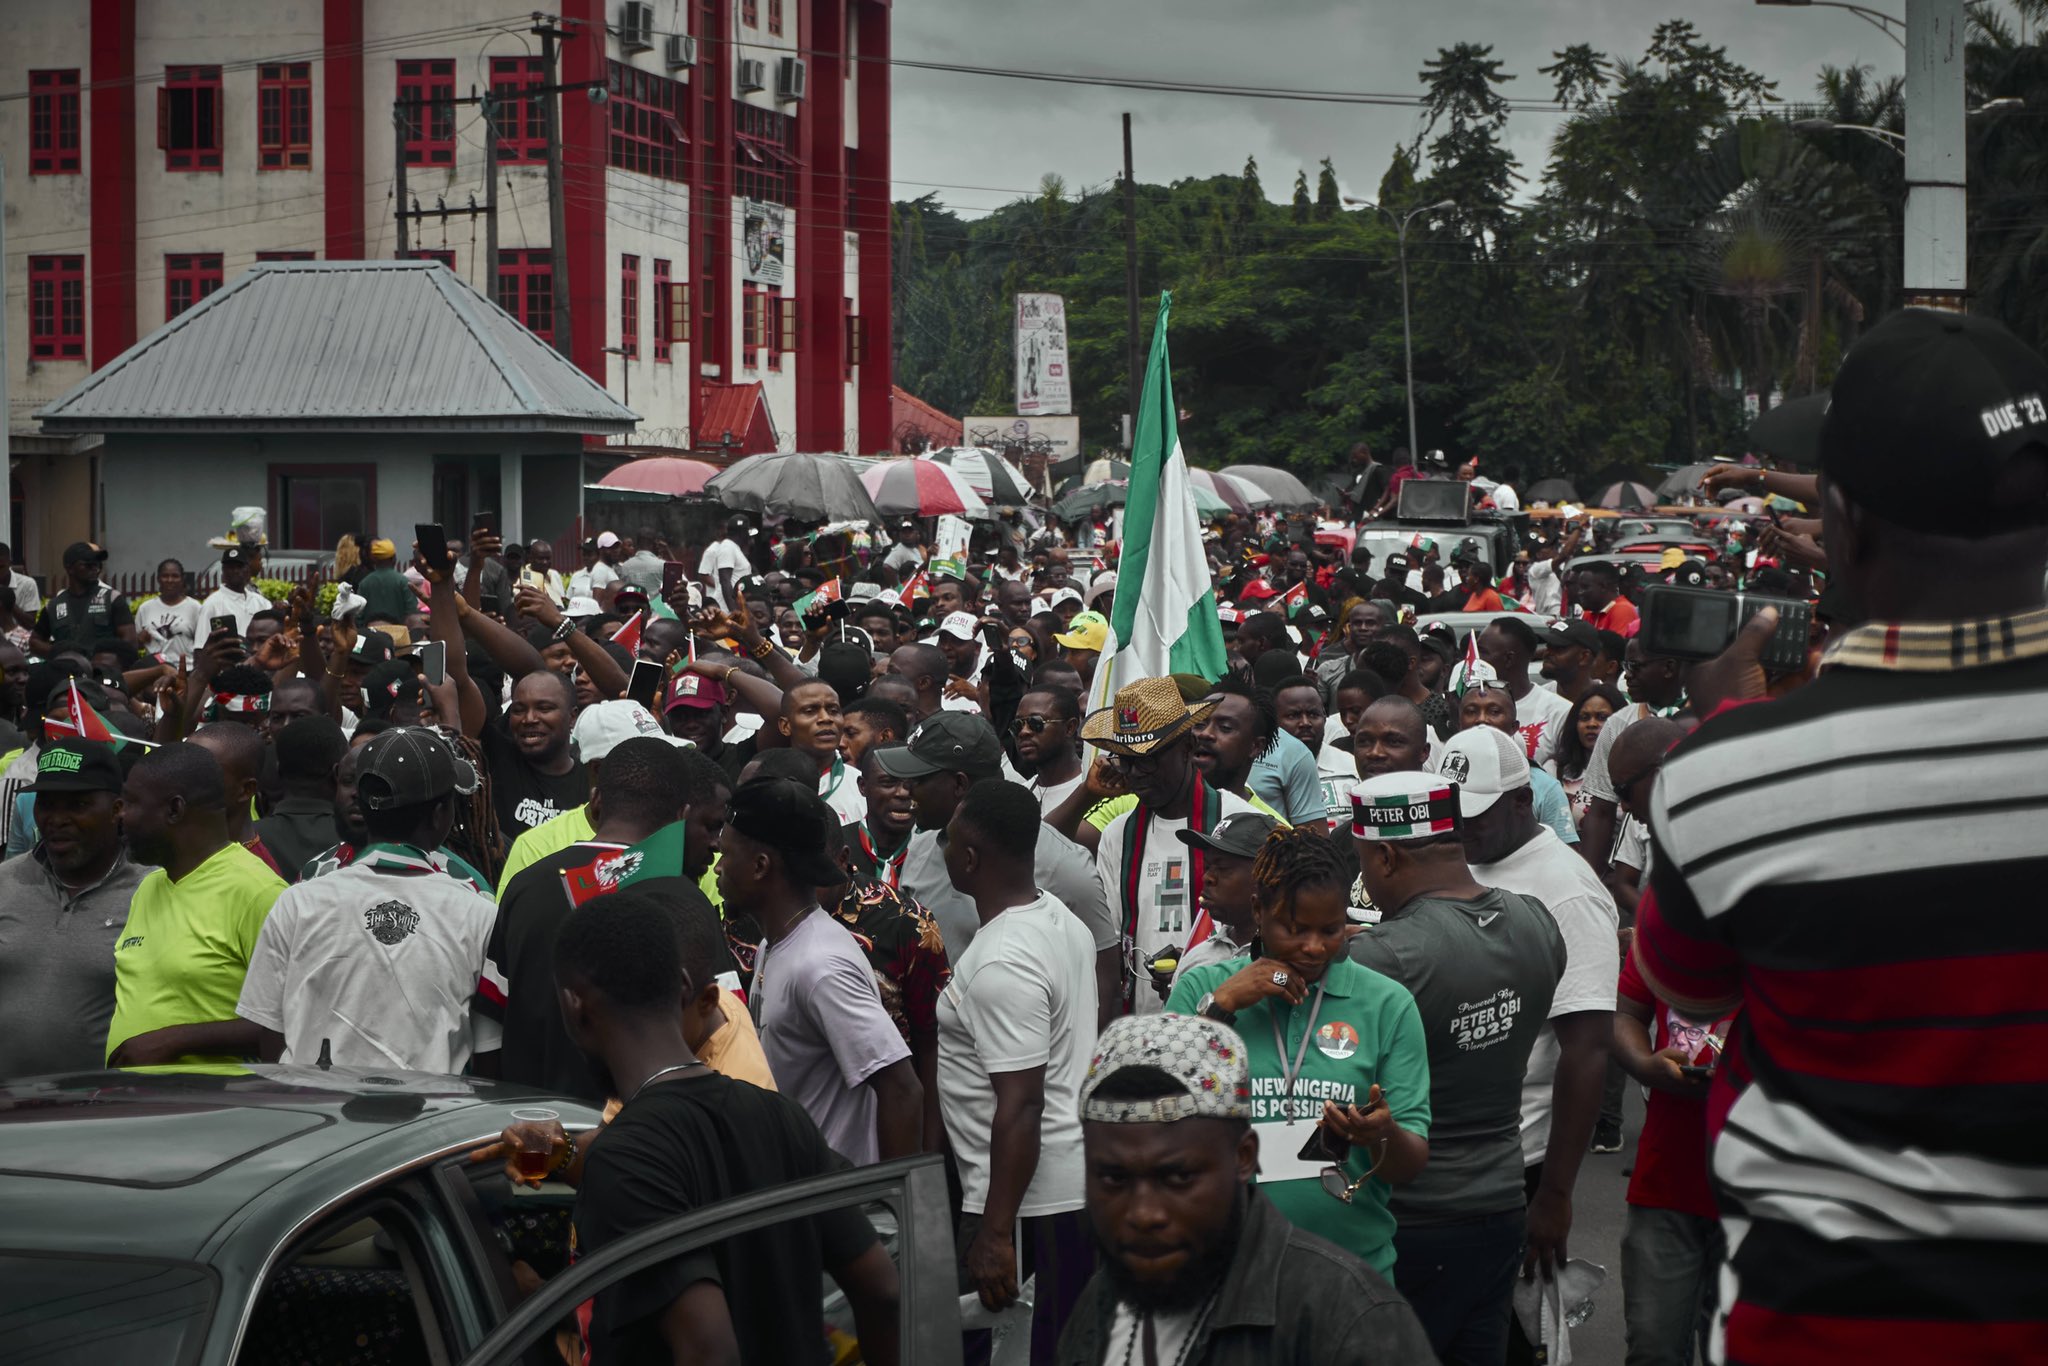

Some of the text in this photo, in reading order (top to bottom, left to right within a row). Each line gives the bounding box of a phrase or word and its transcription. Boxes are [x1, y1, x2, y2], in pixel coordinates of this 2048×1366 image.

[1982, 397, 2047, 437] DUE '23
[50, 752, 83, 770] BRIDGE
[1370, 804, 1430, 823] PETER OBI
[1458, 988, 1515, 1013] Powered By
[1450, 997, 1521, 1034] PETER OBI
[1456, 1017, 1513, 1045] 2023
[1458, 1031, 1510, 1052] Vanguard
[1252, 1078, 1355, 1103] NEW NIGERIA
[1251, 1099, 1324, 1118] IS POSSIB
